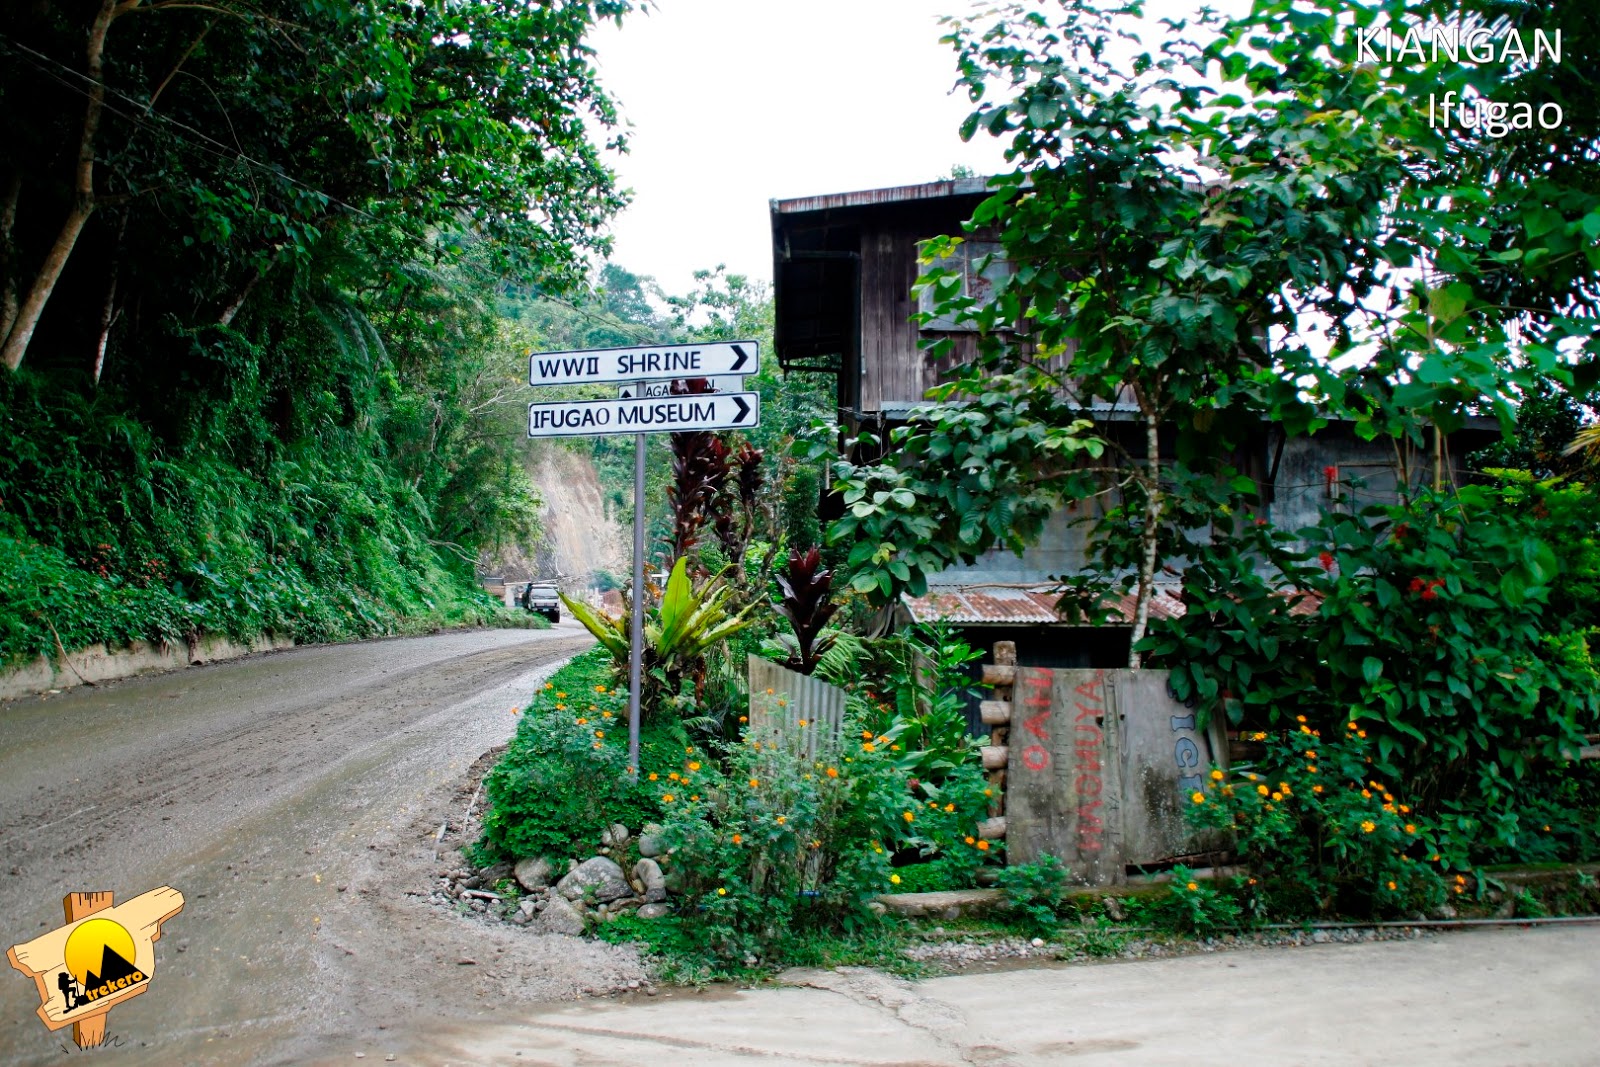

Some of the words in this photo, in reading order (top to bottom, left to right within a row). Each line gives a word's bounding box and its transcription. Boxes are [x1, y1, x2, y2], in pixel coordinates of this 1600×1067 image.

[539, 357, 599, 378] WWII
[617, 351, 701, 374] SHRINE
[533, 407, 610, 429] IFUGAO
[618, 402, 715, 425] MUSEUM
